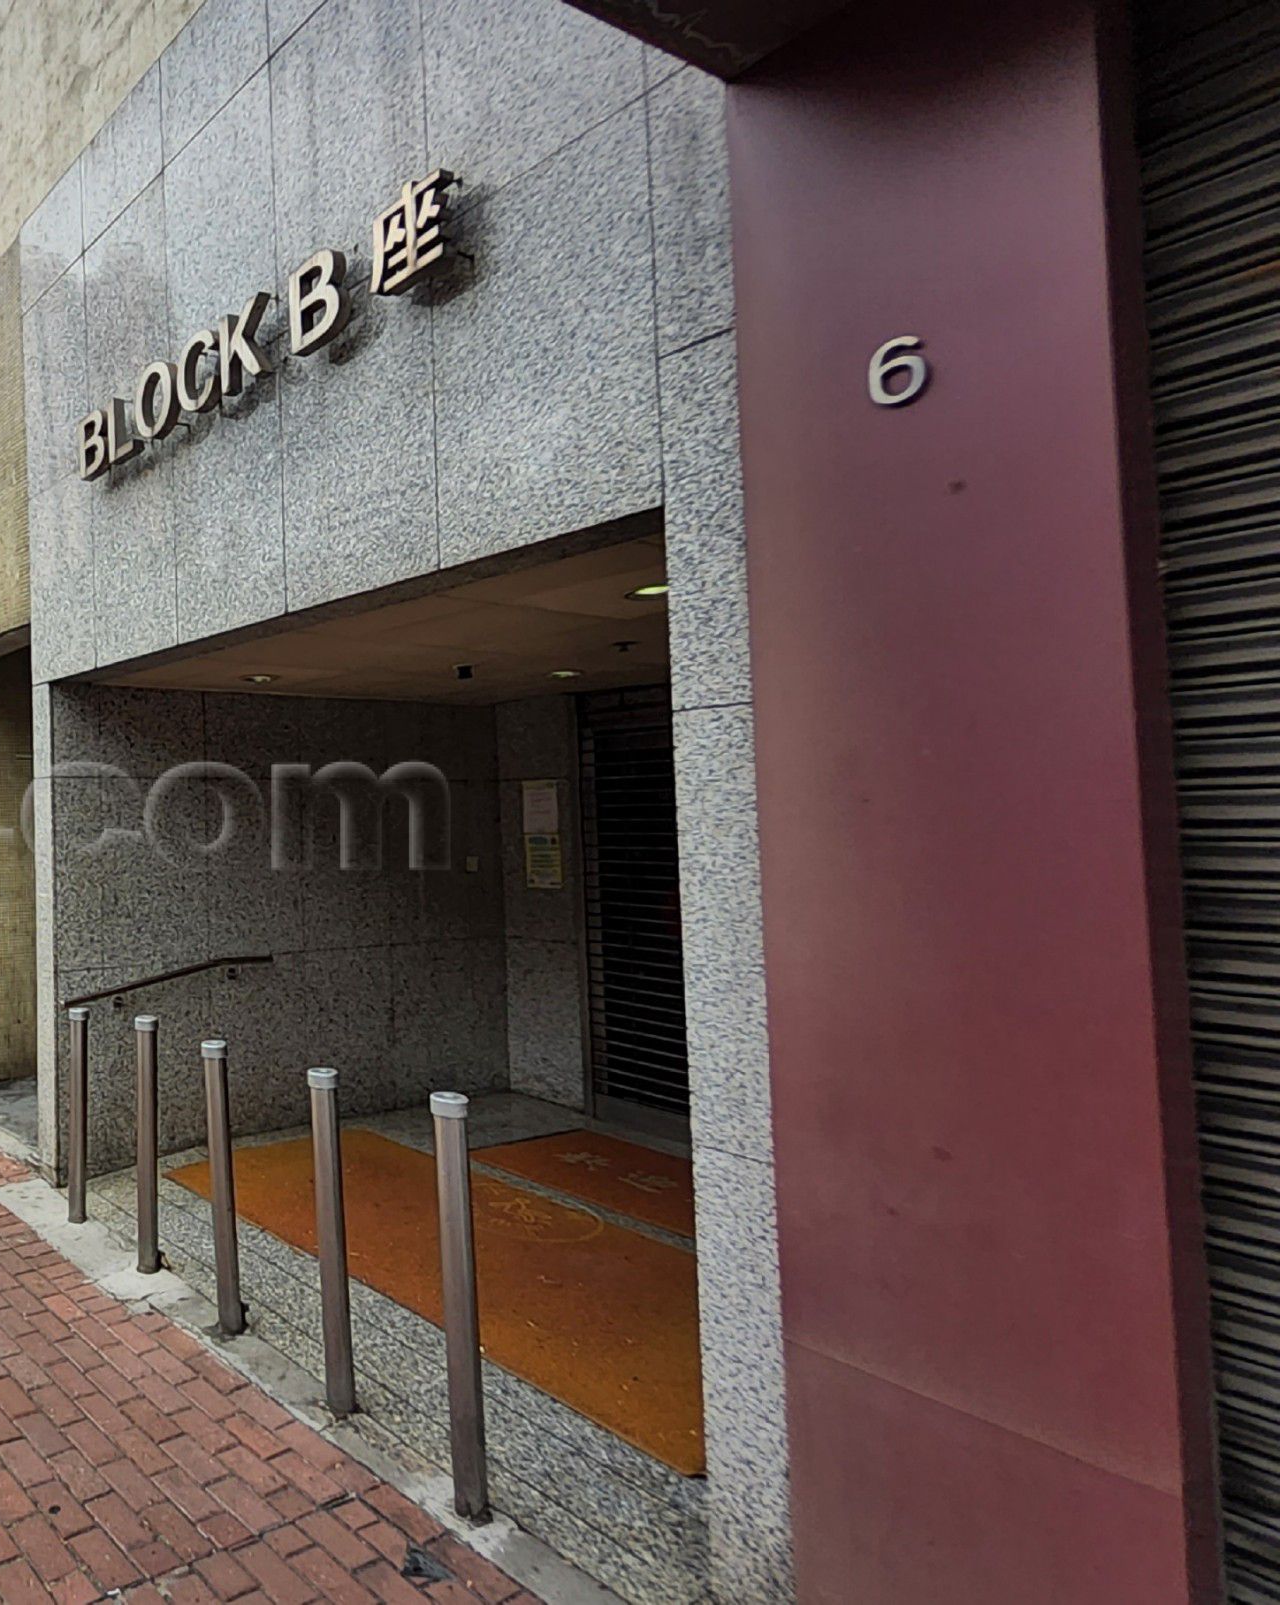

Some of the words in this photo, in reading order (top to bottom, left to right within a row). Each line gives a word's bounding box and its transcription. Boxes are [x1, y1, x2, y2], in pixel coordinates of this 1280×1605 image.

[78, 291, 274, 482] BLOCK
[288, 249, 348, 357] B
[370, 168, 455, 295] 座
[868, 335, 926, 405] 6
